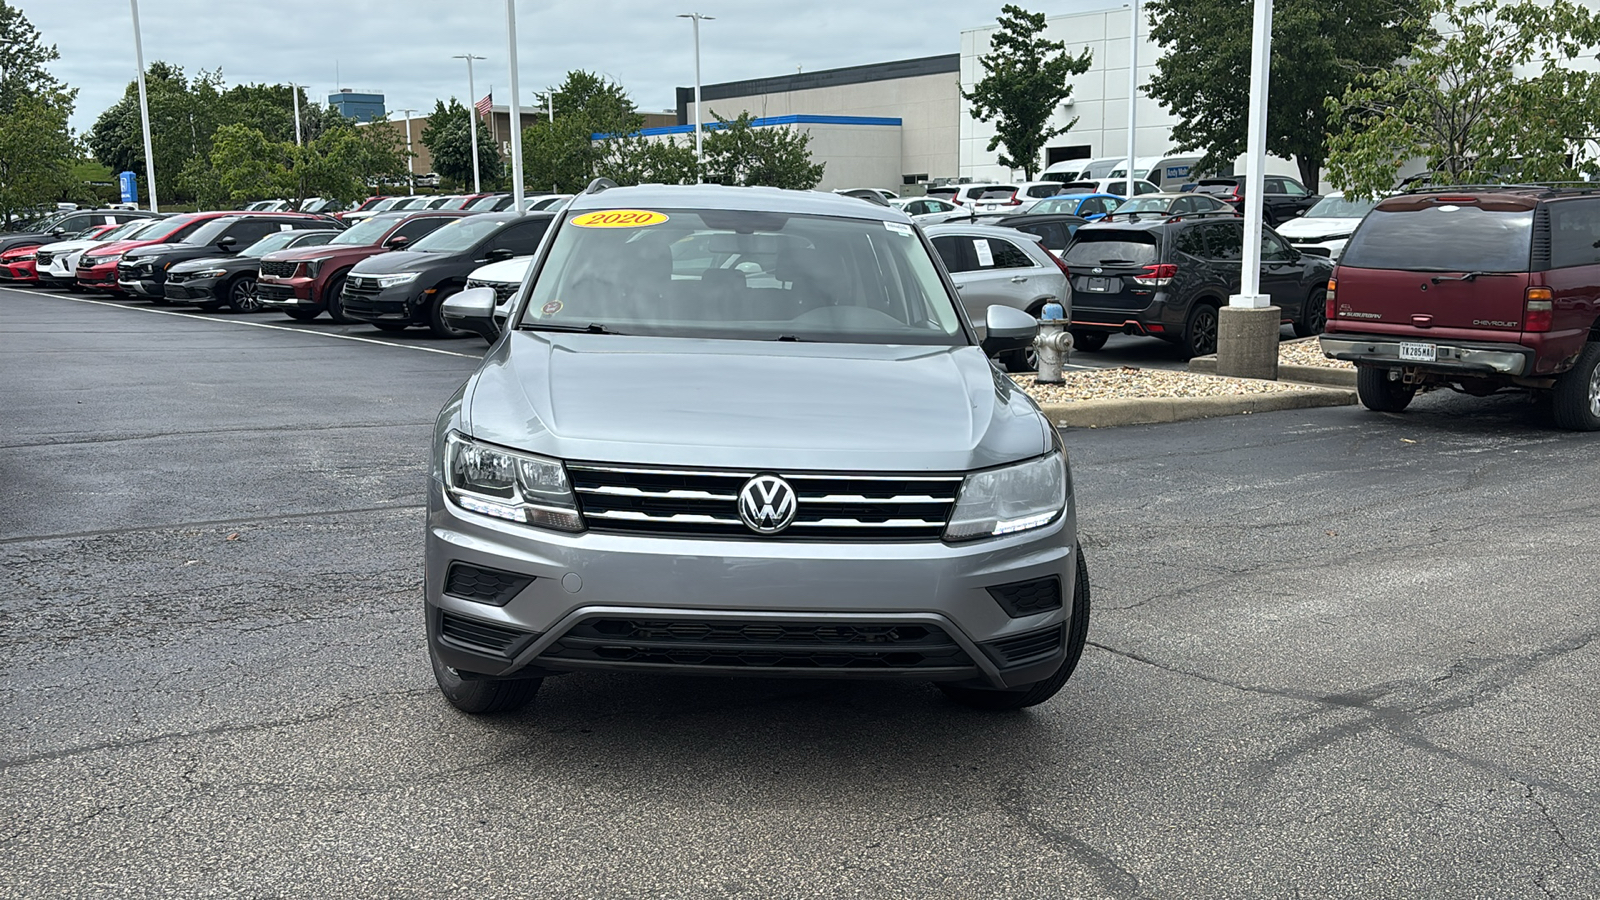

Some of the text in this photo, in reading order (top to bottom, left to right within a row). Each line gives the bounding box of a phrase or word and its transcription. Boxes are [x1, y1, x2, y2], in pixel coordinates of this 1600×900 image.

[585, 213, 653, 225] 2020
[1346, 311, 1382, 319] SUBURBAN
[1472, 319, 1518, 327] CHEVROLET
